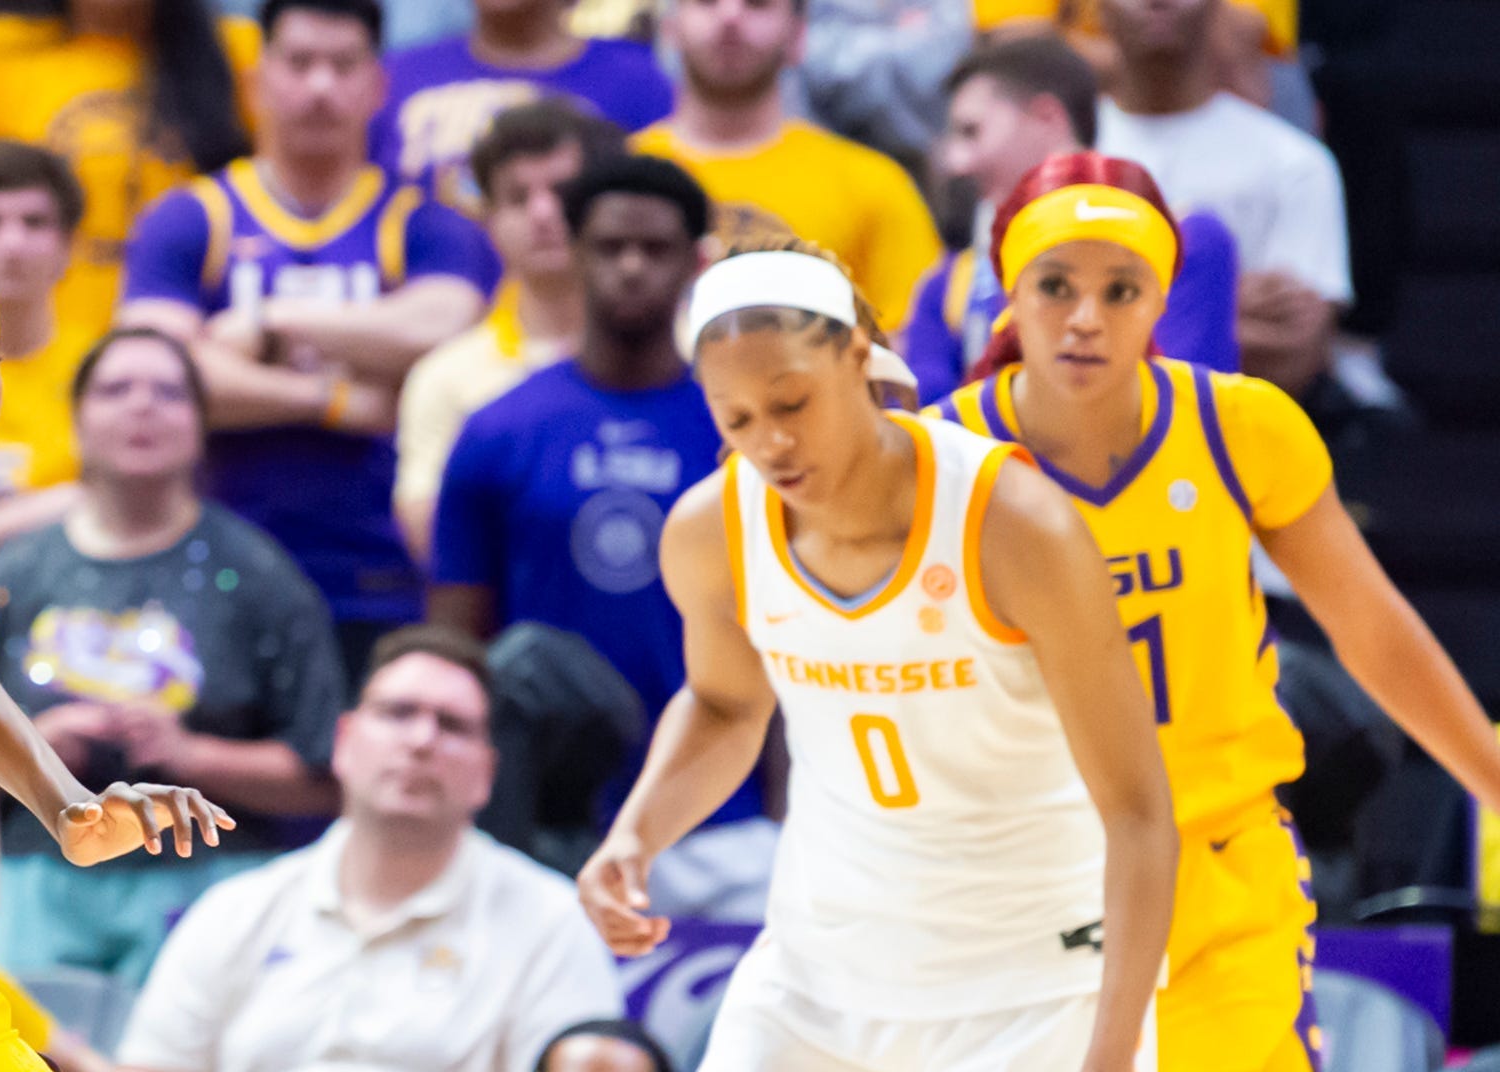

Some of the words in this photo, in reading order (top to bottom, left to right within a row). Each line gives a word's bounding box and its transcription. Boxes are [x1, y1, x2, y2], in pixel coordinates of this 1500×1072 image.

[1106, 547, 1183, 597] SU
[768, 649, 978, 695] TENNESSEE
[850, 713, 920, 809] 0
